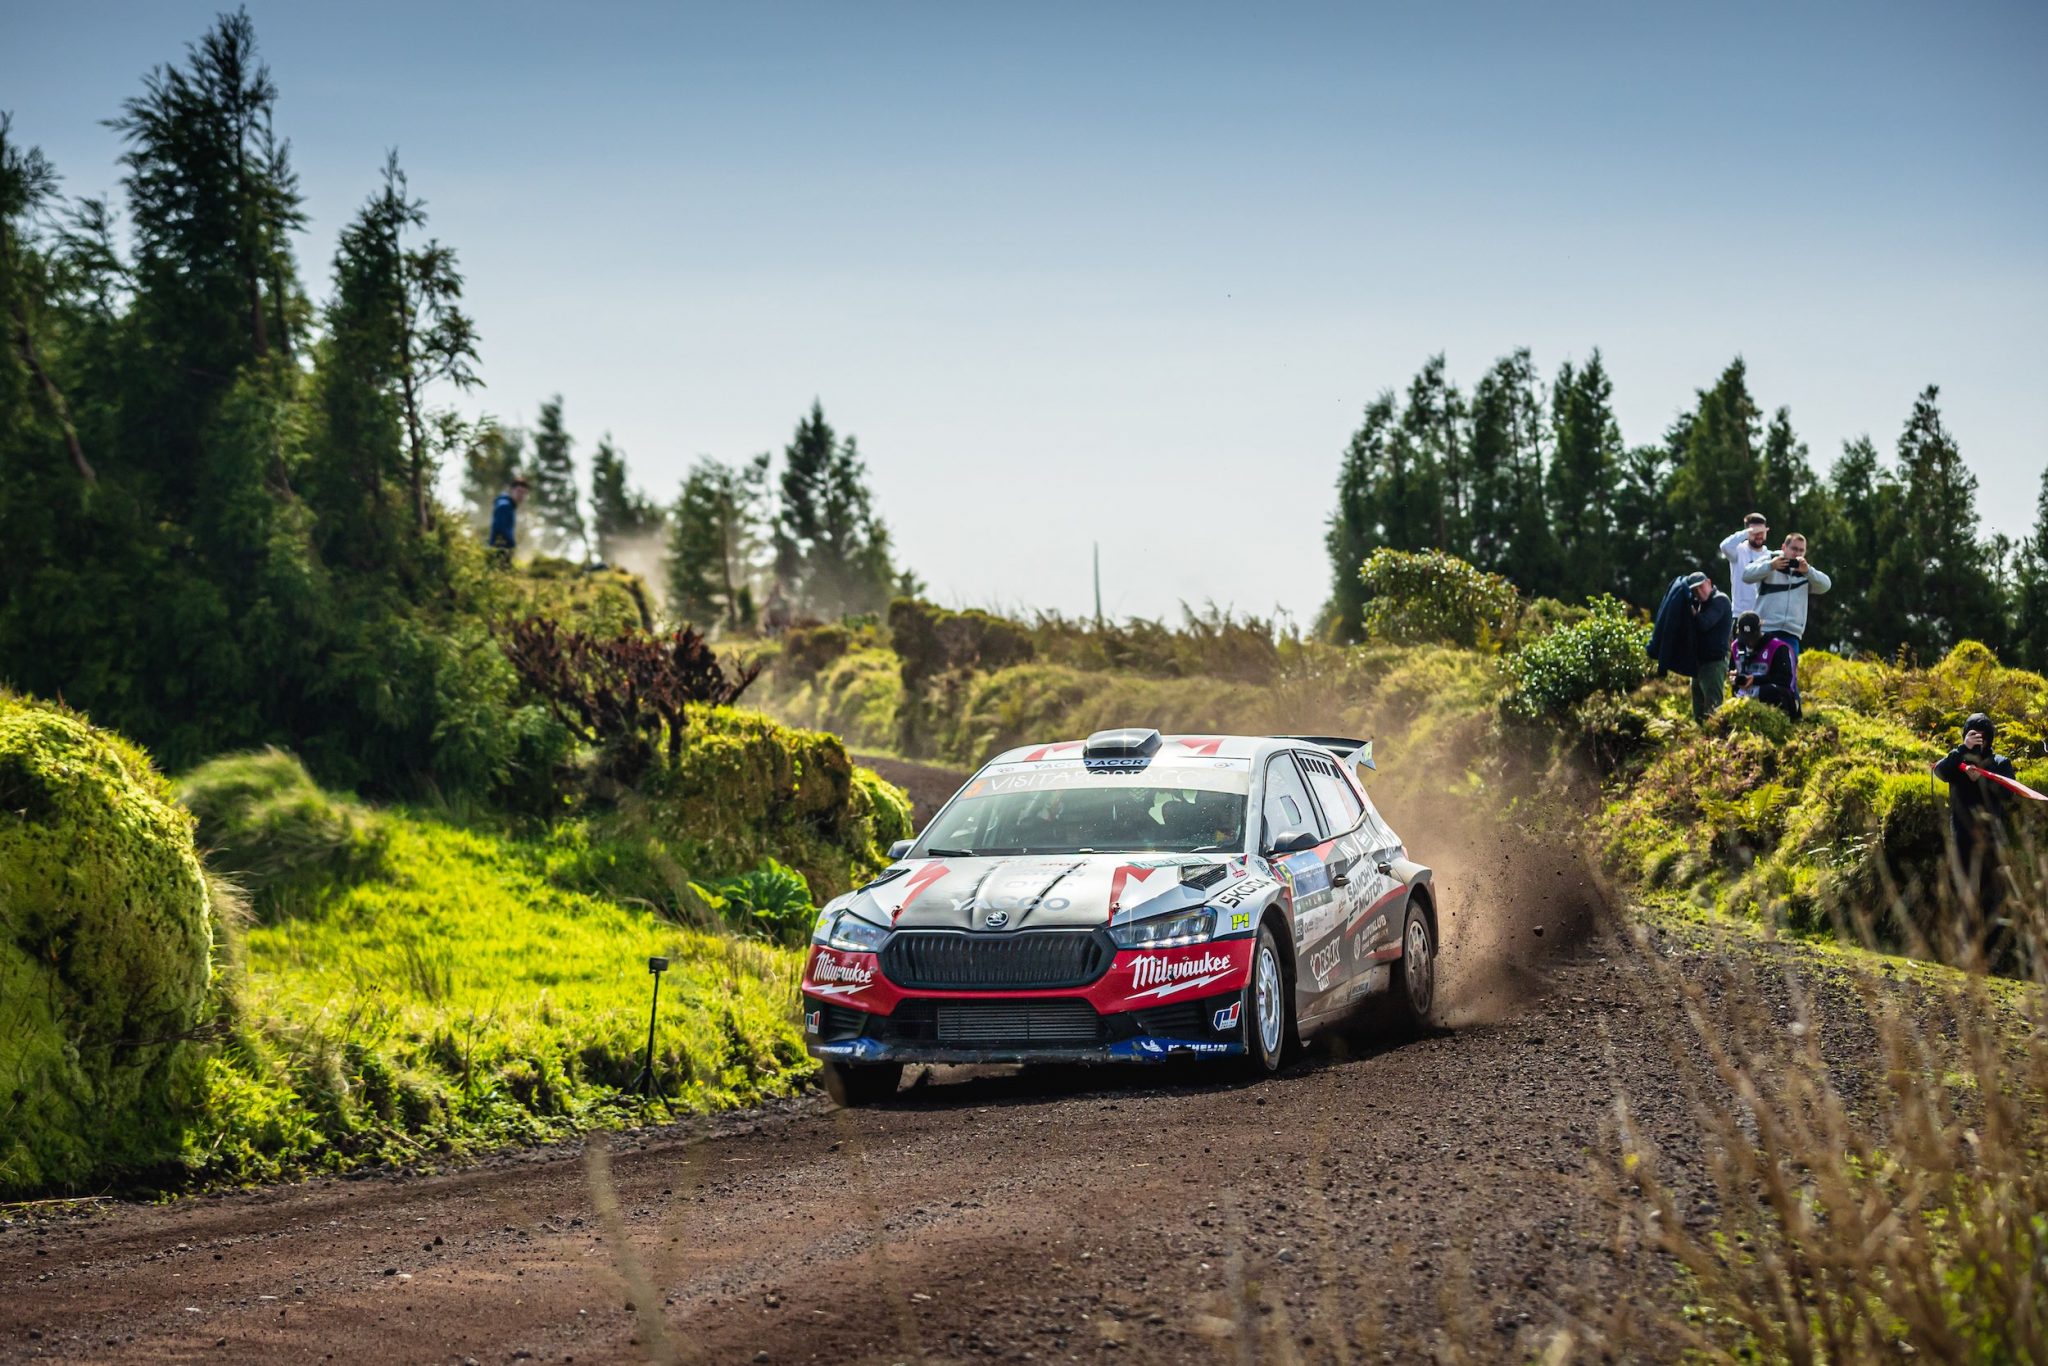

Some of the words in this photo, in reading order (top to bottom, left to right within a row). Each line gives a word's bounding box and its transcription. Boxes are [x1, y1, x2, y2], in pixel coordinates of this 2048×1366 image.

[951, 897, 1071, 911] YACCO
[813, 950, 873, 983] Milwaukee
[1126, 951, 1231, 990] Milwaukee
[1168, 1044, 1228, 1052] MHELIN
